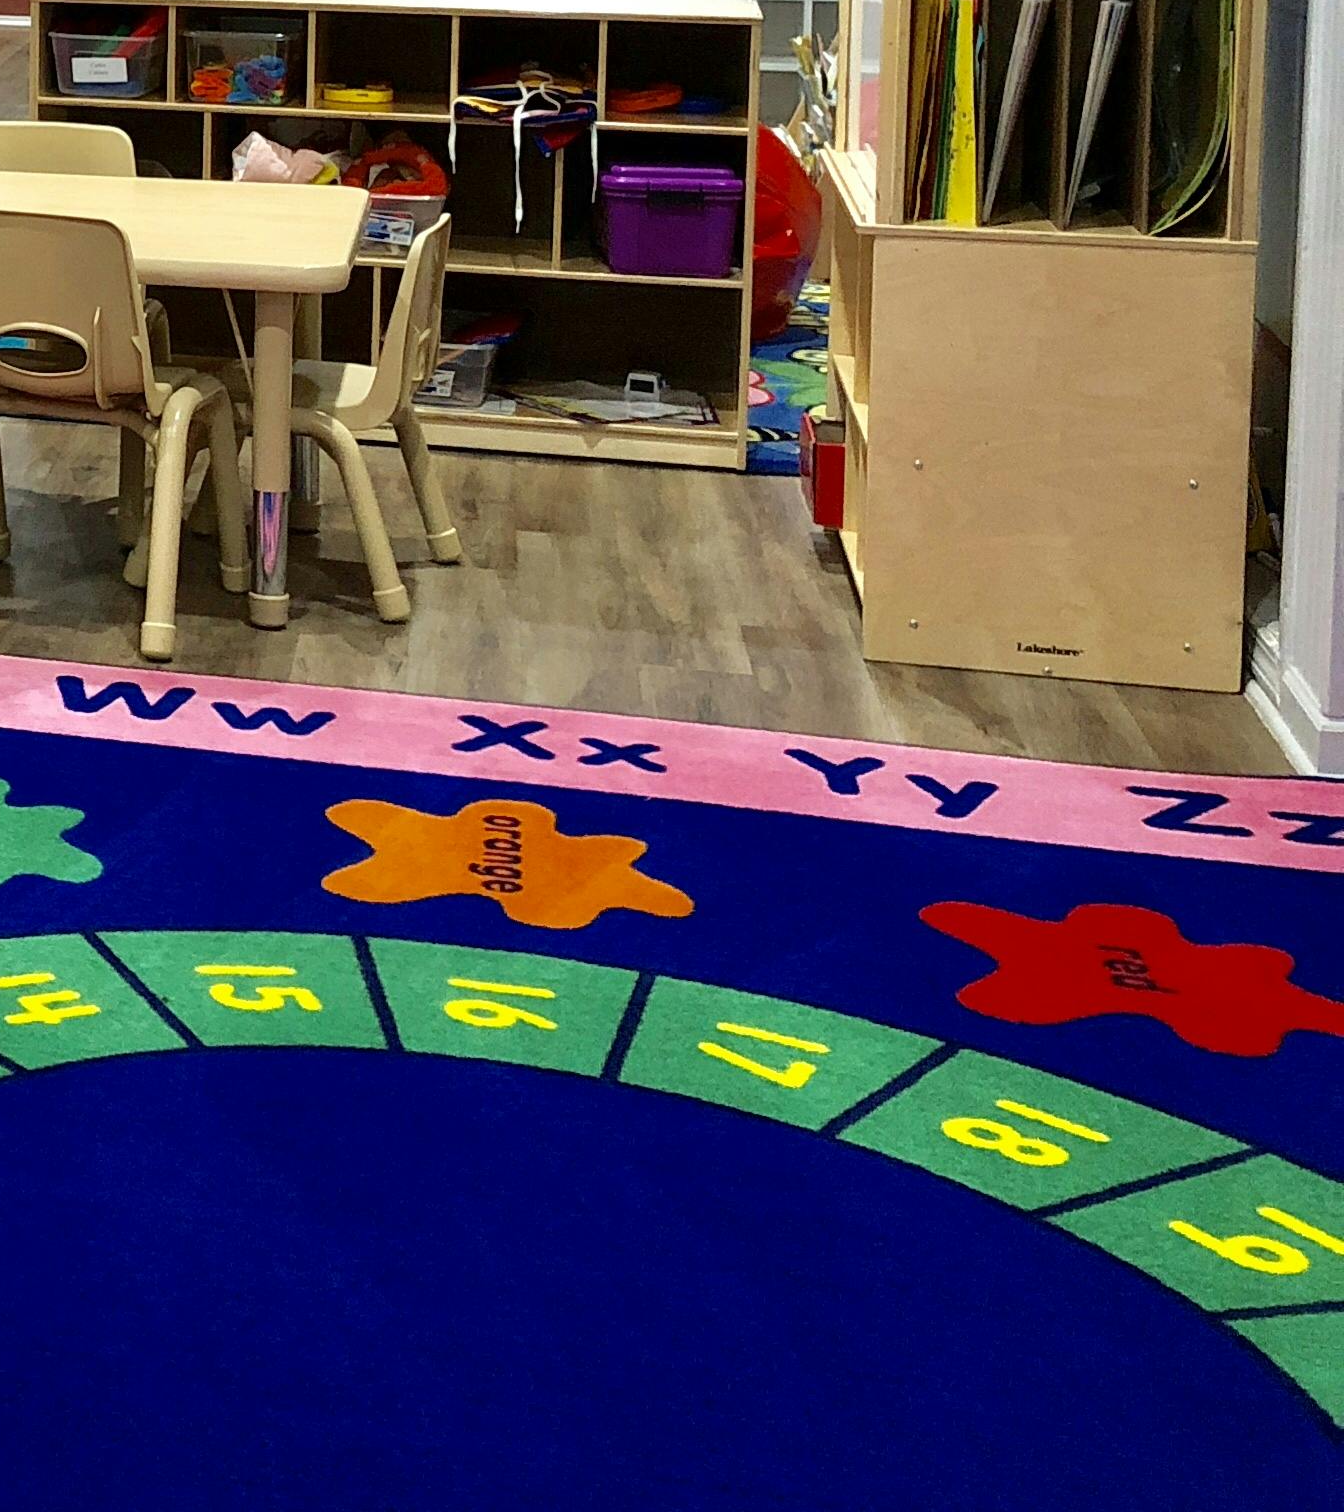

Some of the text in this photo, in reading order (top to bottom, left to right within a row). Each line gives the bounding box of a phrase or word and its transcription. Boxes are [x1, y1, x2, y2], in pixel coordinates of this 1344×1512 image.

[56, 674, 336, 736] Ww
[452, 713, 668, 773] Xx
[784, 748, 1000, 819] Yy
[1126, 786, 1344, 846] Zz
[470, 814, 524, 894] orange
[194, 964, 324, 1013] 15
[443, 977, 559, 1031] 16
[1097, 945, 1180, 995] red
[697, 1021, 831, 1089] 17
[940, 1099, 1111, 1168] 18
[1168, 1205, 1344, 1276] 19
